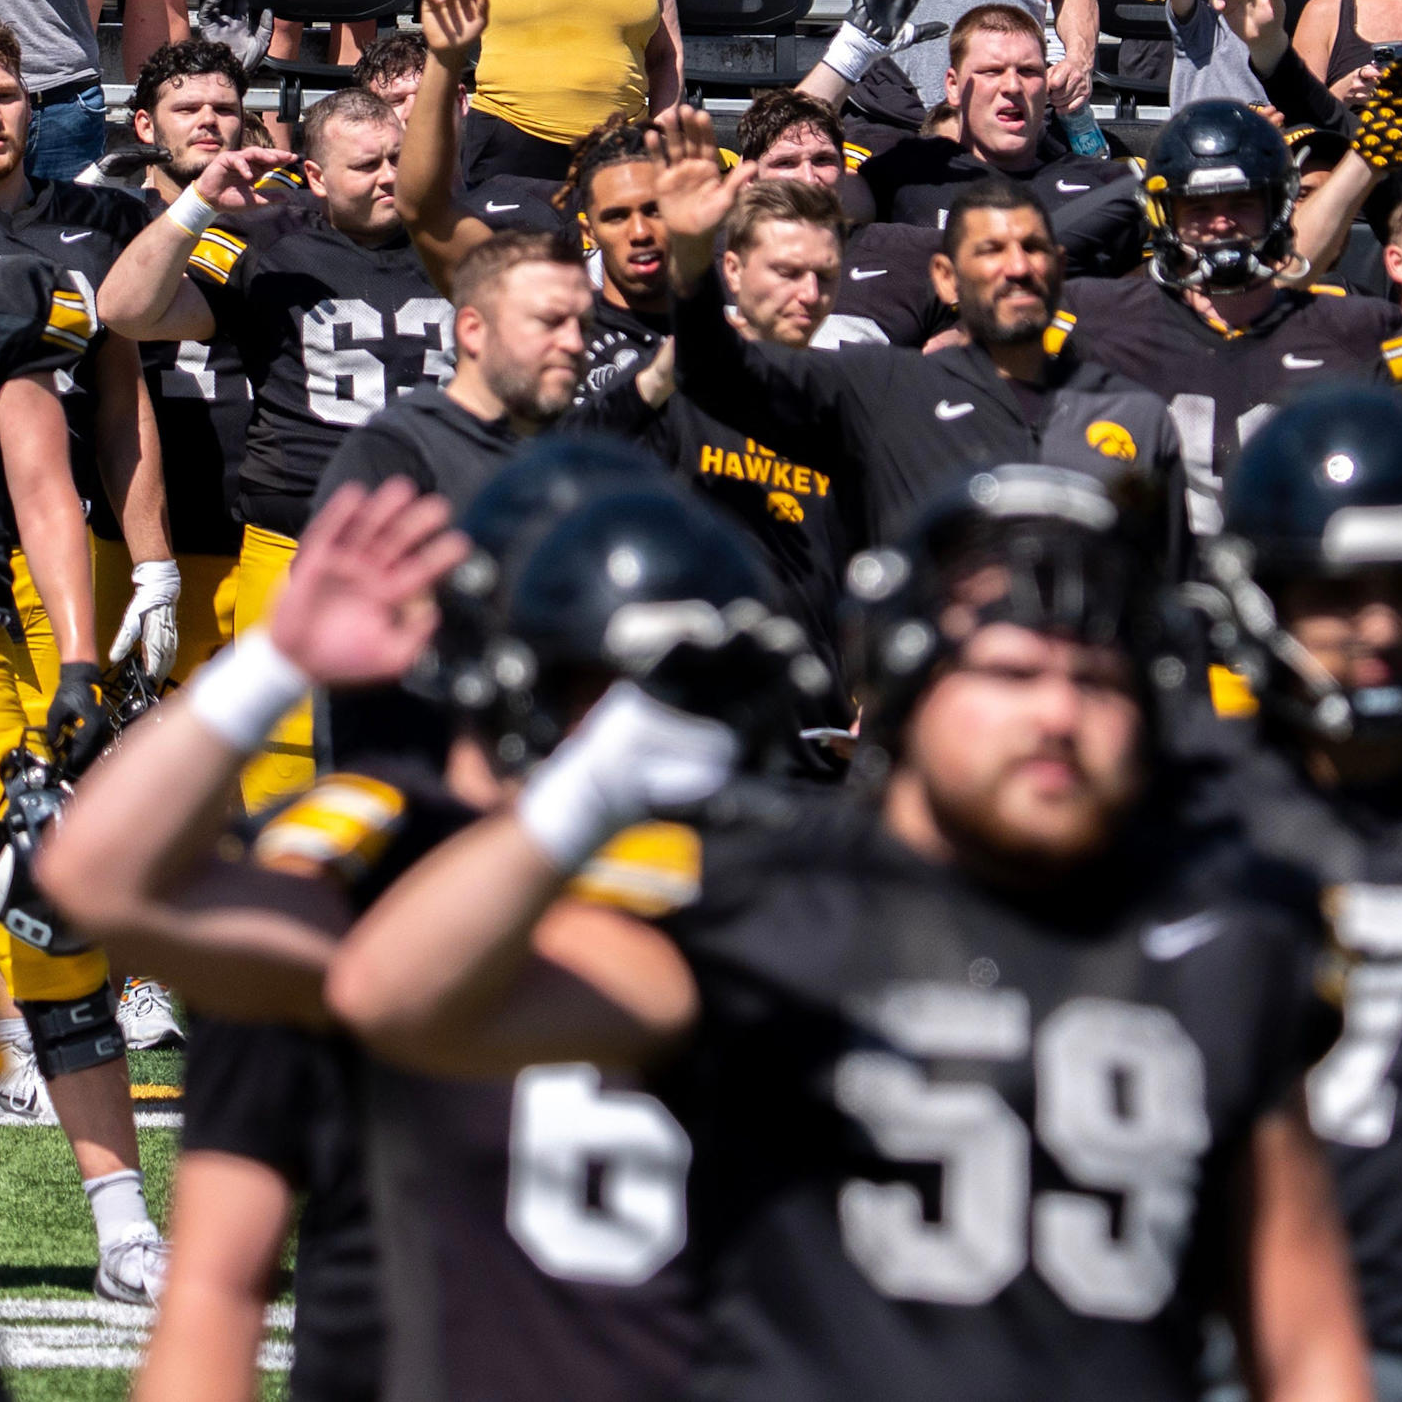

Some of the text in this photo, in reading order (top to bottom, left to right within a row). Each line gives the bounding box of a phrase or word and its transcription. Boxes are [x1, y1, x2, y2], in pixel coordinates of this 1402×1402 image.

[301, 299, 457, 427] 63
[700, 444, 831, 497] HAWKEY
[833, 986, 1211, 1320] 59
